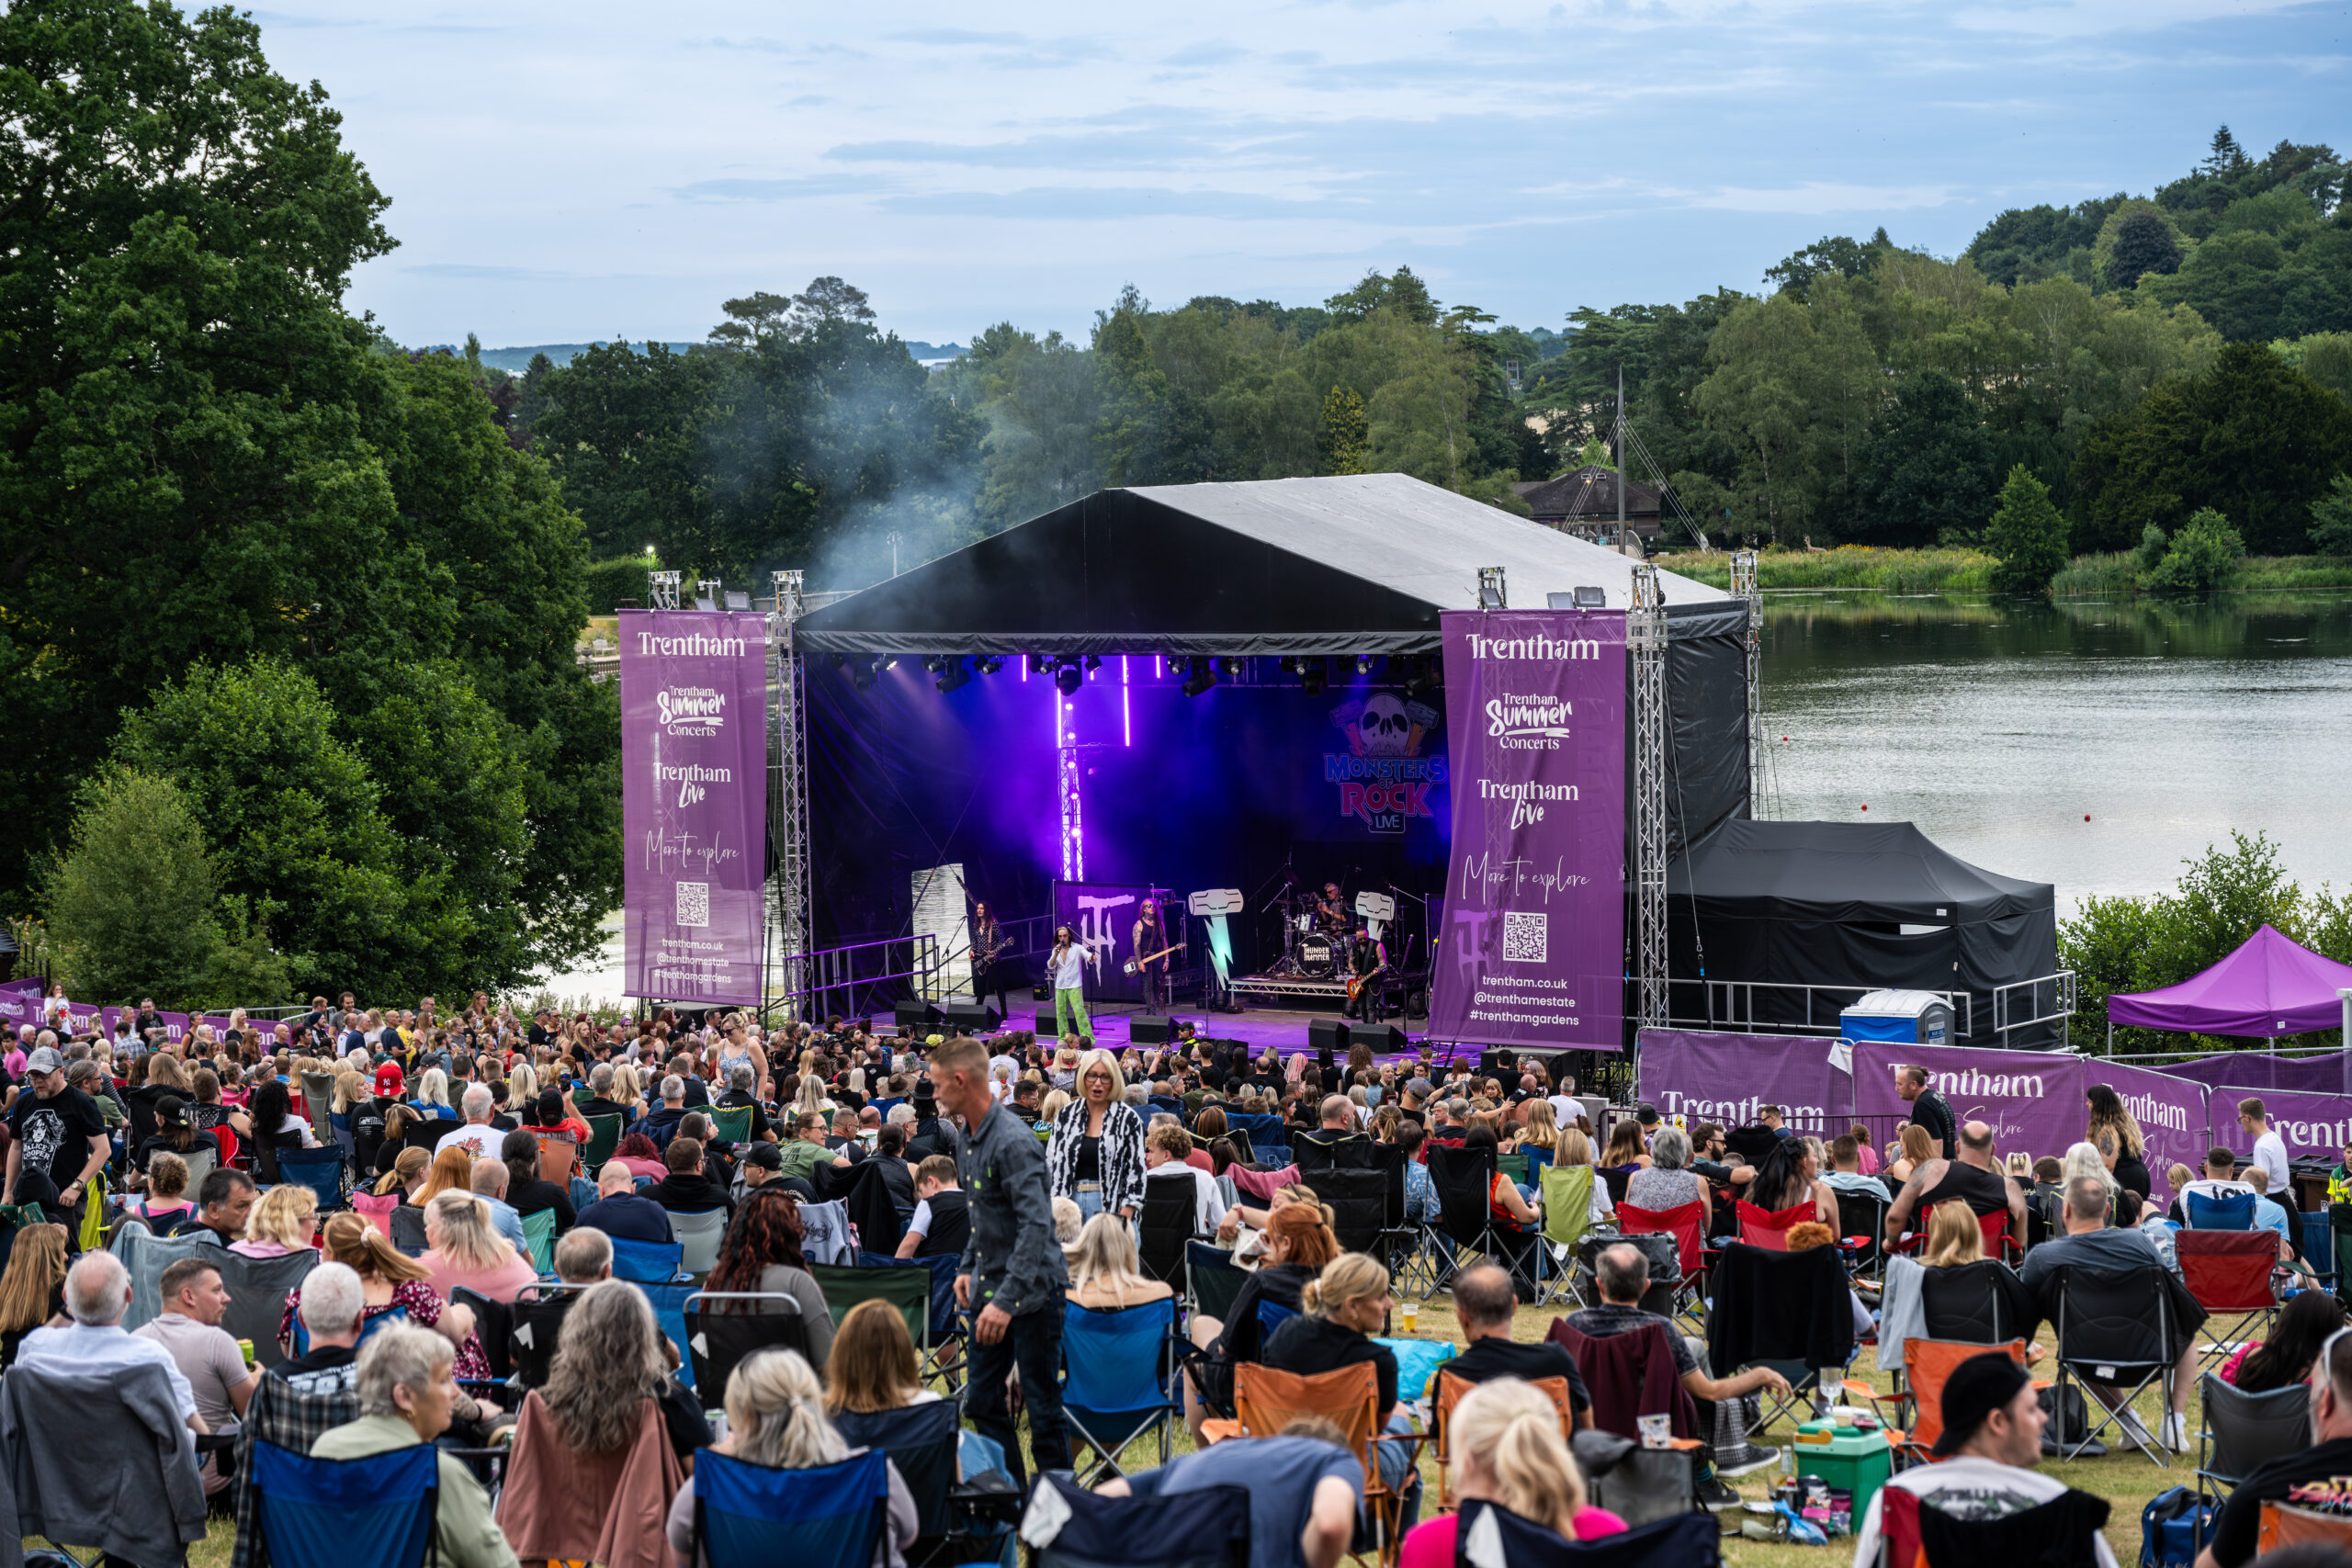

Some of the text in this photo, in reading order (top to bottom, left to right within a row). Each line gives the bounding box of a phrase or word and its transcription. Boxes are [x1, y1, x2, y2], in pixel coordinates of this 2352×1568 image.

[638, 632, 745, 657] Trentham
[1466, 634, 1600, 660] Trentham
[669, 685, 715, 697] Trentham
[1502, 693, 1558, 705] Trentham
[657, 691, 726, 725] Summer
[1486, 700, 1573, 737] Summer
[667, 724, 717, 737] Concerts
[1499, 736, 1560, 750] Concerts
[652, 762, 731, 782] Trentham
[678, 781, 706, 808] Live
[1476, 779, 1579, 801] Trentham
[1340, 782, 1433, 825] ROCK
[1375, 815, 1400, 829] LIVE
[1510, 798, 1544, 830] Live
[646, 827, 741, 874] More to explore
[1463, 851, 1591, 905] More to explore
[662, 938, 724, 952] trentham.co.uk
[656, 952, 729, 968] @trenthamestate
[653, 969, 732, 985] #trenthamgardens
[1482, 975, 1568, 989] trentham.co.uk
[1474, 991, 1576, 1009] @trenthamestate
[1470, 1010, 1579, 1027] #trenthamgardens
[23, 1149, 51, 1160] COOPER
